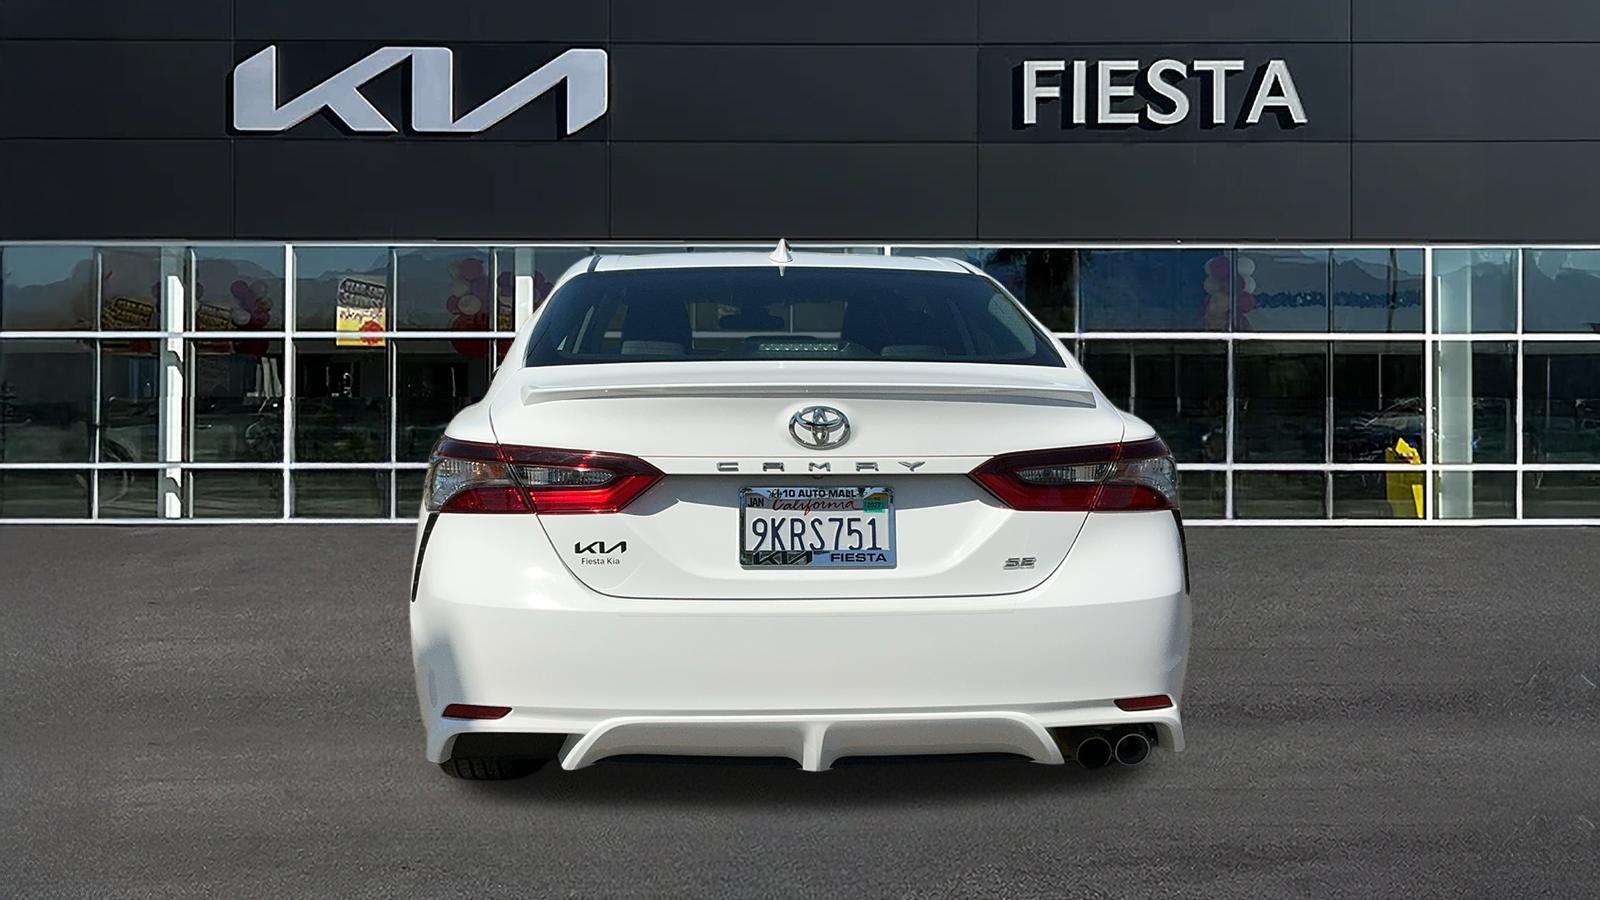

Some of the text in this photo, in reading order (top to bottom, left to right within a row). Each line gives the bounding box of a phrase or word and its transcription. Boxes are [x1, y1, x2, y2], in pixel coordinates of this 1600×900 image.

[234, 45, 608, 134] KIA
[1023, 59, 1308, 125] FIESTA
[717, 461, 926, 472] CAMRY
[798, 489, 824, 498] AUTO
[828, 489, 857, 498] MALL
[748, 497, 764, 507] JAN
[772, 499, 856, 516] California
[752, 518, 882, 553] 9KRS751
[575, 541, 627, 553] KIA
[581, 557, 620, 565] Fiesta Kia
[830, 553, 887, 562] FIESTA
[1004, 557, 1037, 569] SE
